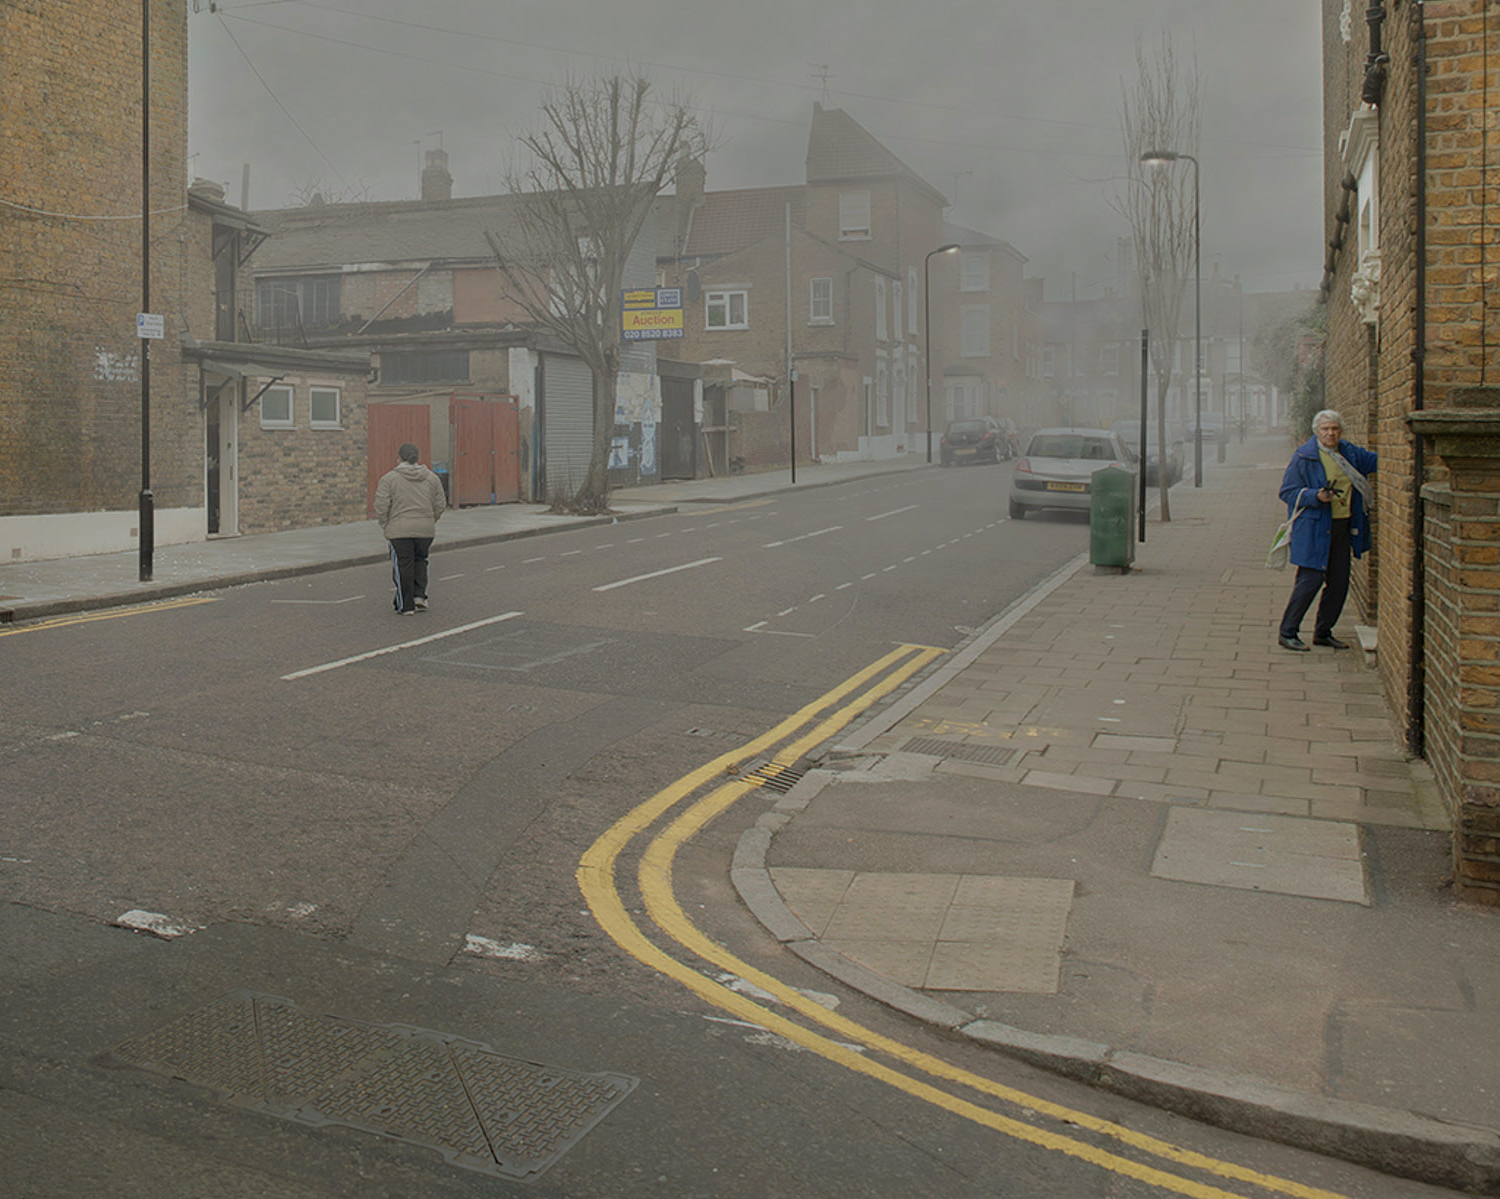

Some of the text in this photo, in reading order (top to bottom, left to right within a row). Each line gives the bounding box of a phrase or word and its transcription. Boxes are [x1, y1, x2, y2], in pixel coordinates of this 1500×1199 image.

[632, 315, 675, 326] Auction
[624, 329, 683, 339] 020 8520 8383
